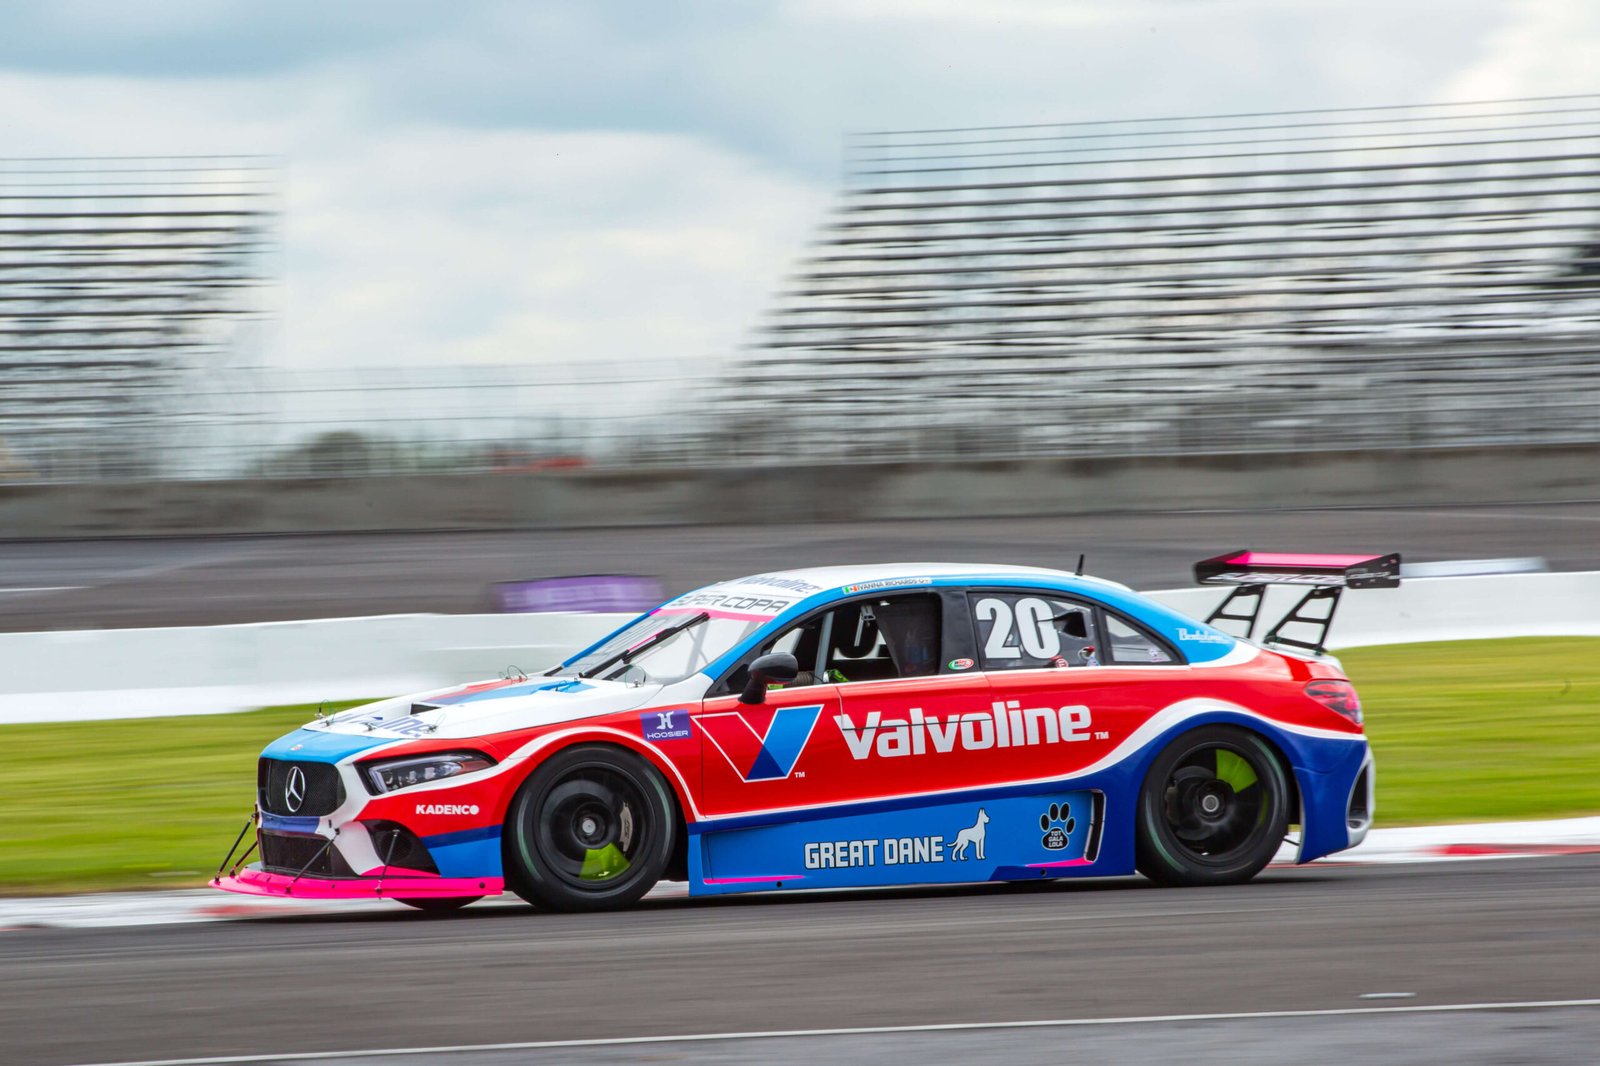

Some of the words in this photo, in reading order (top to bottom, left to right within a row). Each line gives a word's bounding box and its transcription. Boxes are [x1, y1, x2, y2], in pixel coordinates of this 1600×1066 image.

[720, 597, 789, 612] COPA
[975, 598, 1060, 659] 20
[647, 730, 689, 739] HOOSIER
[833, 700, 1092, 760] Valvoline
[415, 804, 480, 815] KADENCO
[804, 839, 879, 870] GREAT
[883, 835, 944, 864] DANE
